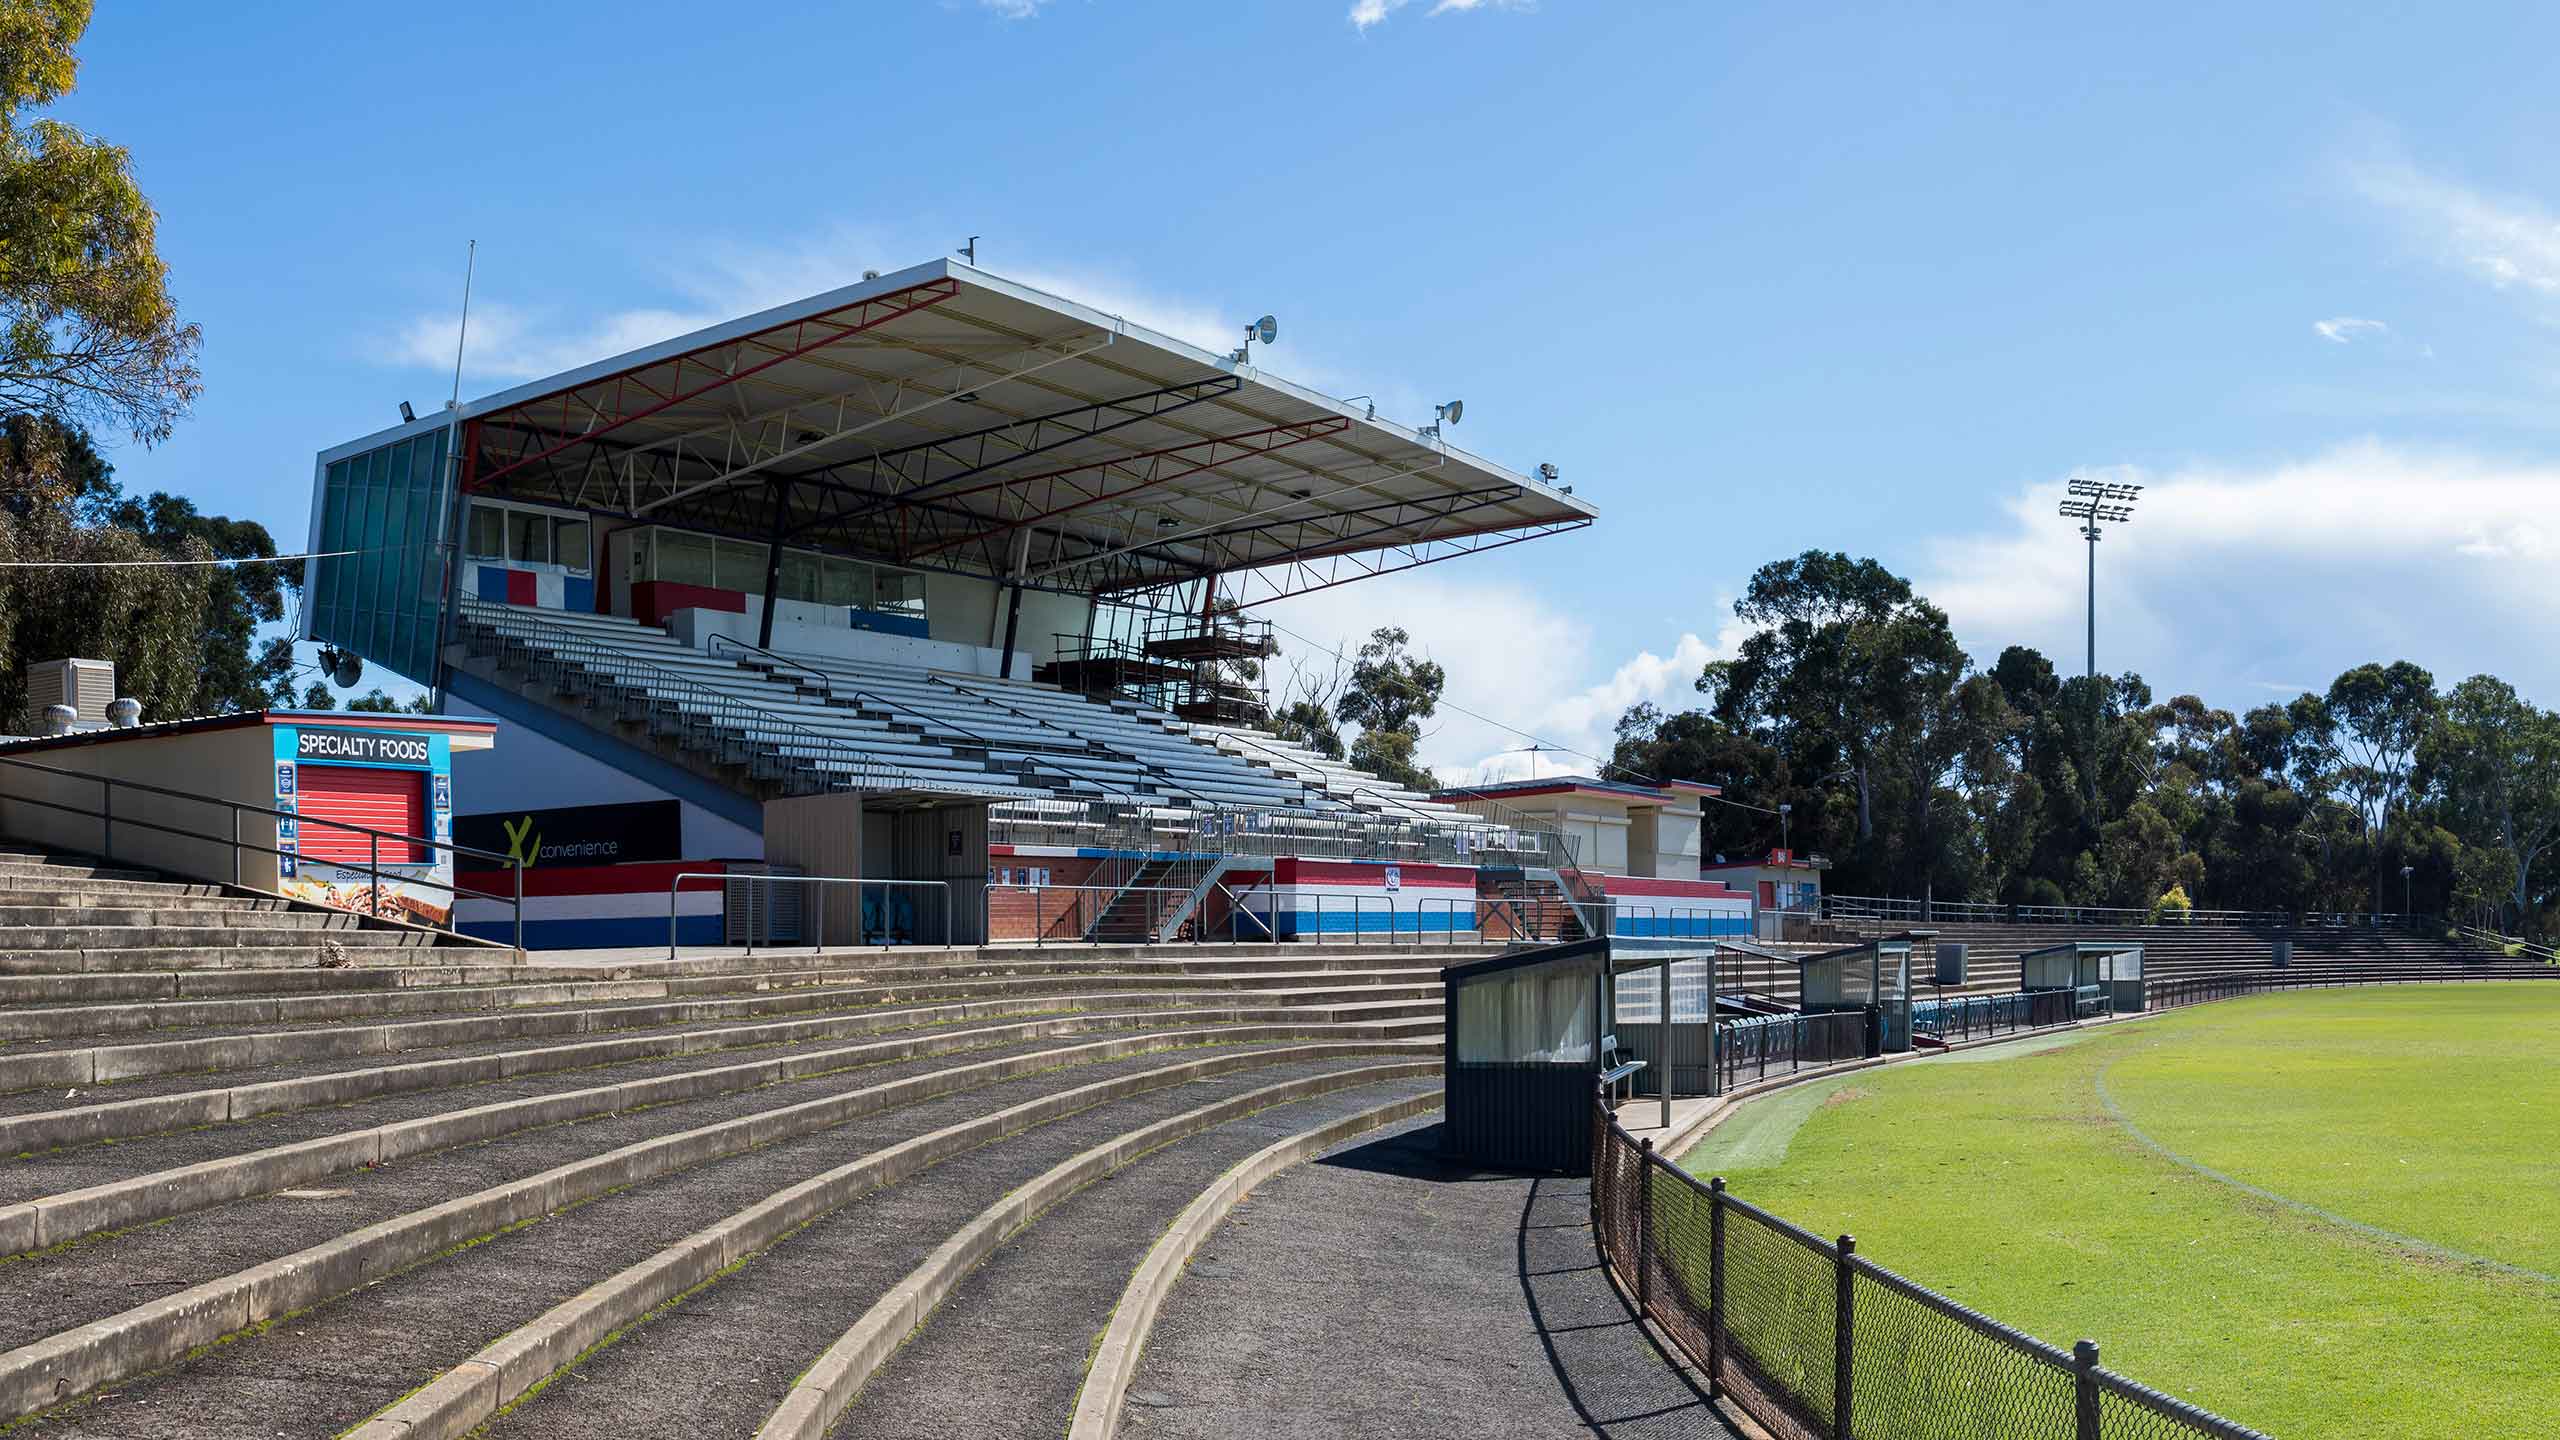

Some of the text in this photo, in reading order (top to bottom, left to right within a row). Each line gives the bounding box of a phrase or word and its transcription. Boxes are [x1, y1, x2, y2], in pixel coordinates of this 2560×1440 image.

[299, 734, 428, 760] SPECIALTY FOODS
[540, 839, 618, 858] convenience
